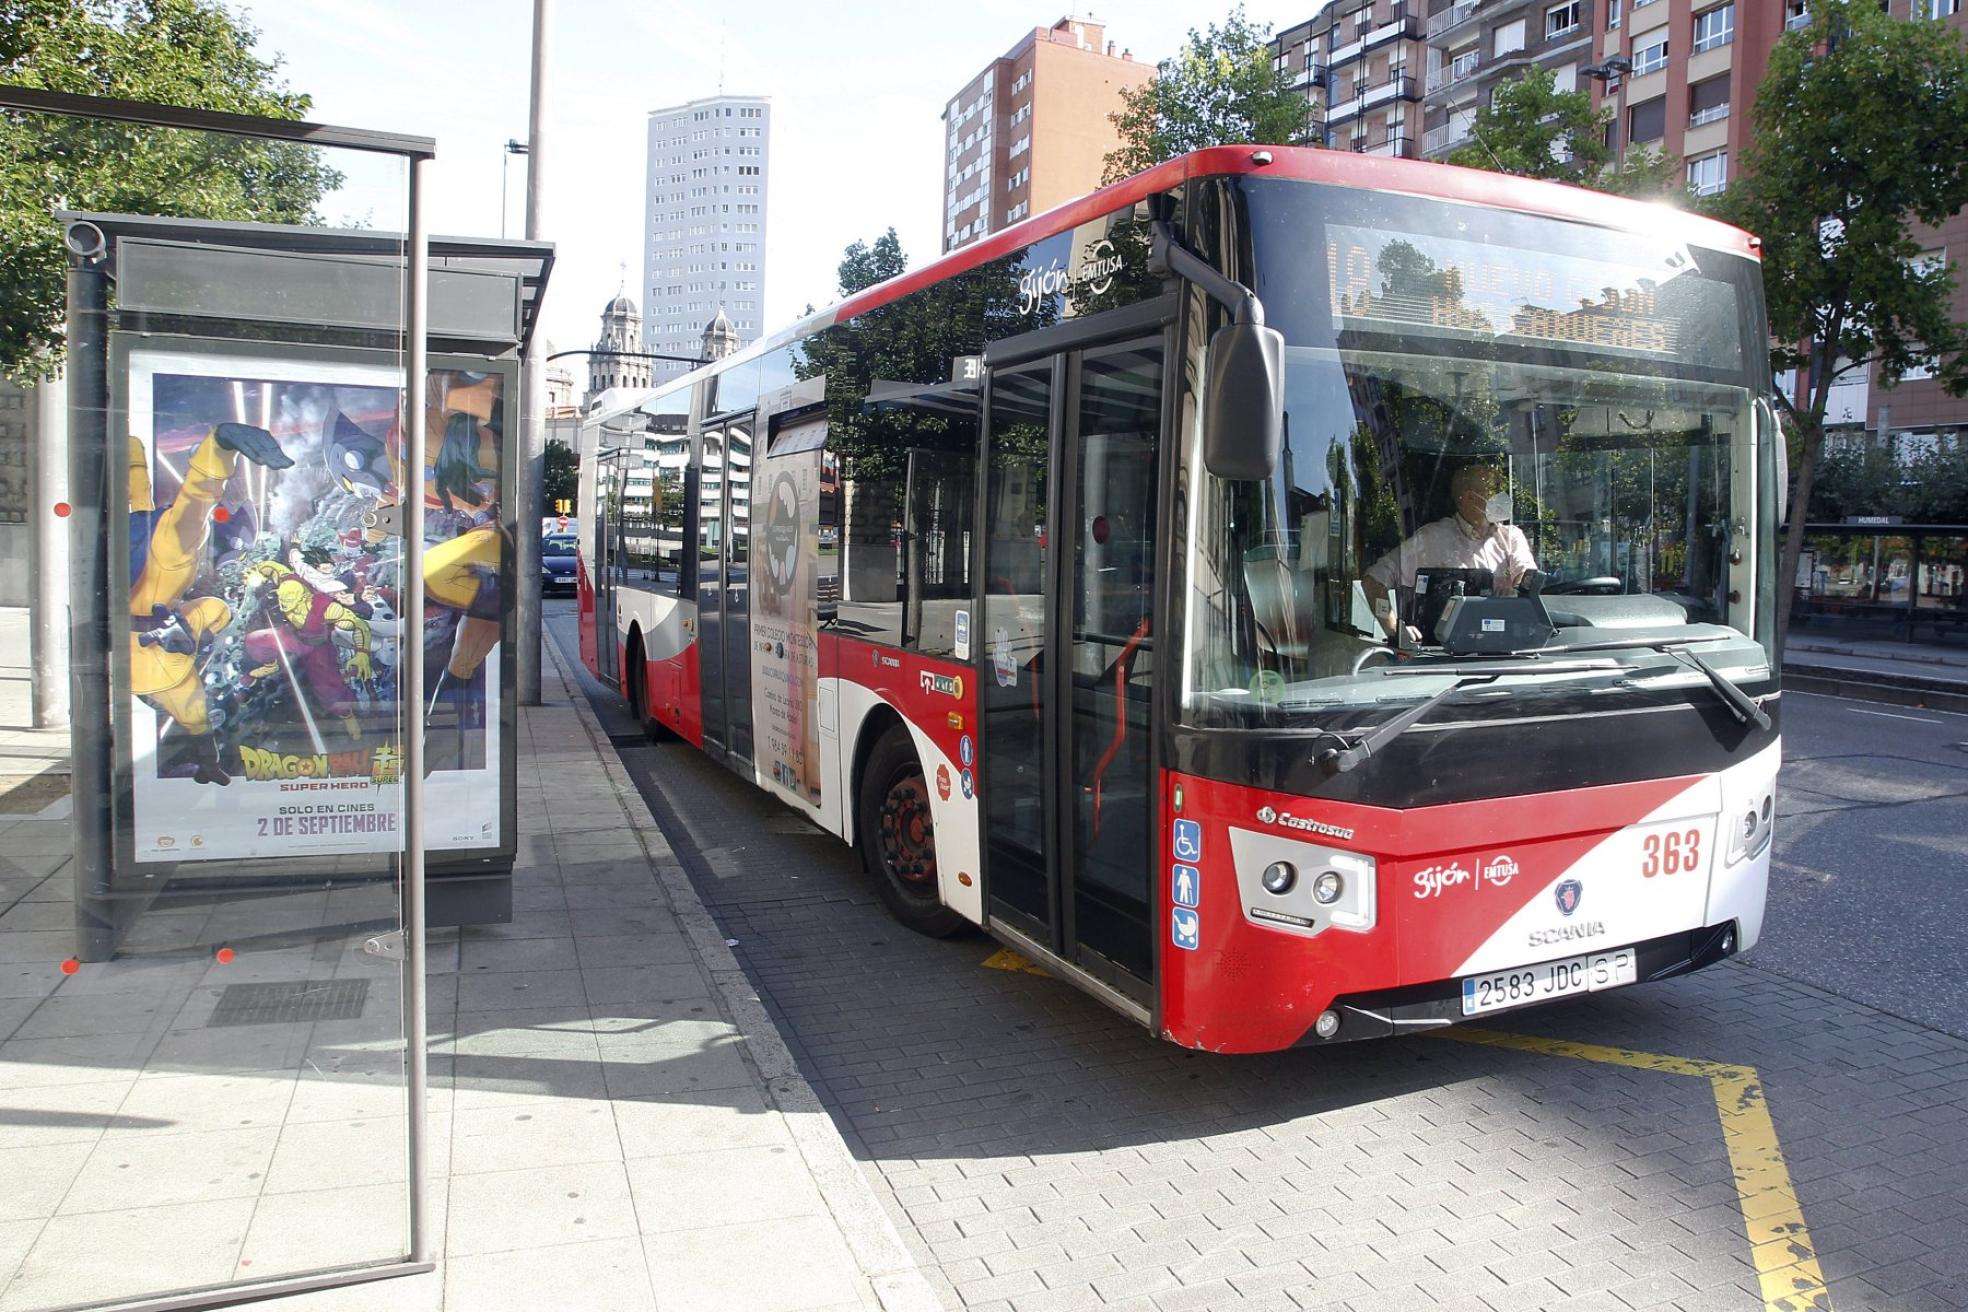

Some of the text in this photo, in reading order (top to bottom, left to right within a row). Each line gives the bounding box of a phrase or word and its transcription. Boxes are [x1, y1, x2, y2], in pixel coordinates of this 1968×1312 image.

[1082, 254, 1123, 283] EMTUSA
[1019, 258, 1069, 315] gijón
[238, 744, 329, 782] DRAGON
[280, 781, 369, 792] SUPER HERO
[279, 803, 375, 815] SOLO EN CINES
[257, 813, 397, 837] 2 DE SEPTIEMBRE
[1278, 812, 1354, 840] Castrosua
[1642, 828, 1701, 879] 363
[1413, 861, 1470, 899] gijón
[1484, 862, 1519, 880] EMTUSA
[1528, 920, 1606, 948] SCANIA
[1479, 961, 1582, 1007] 2583 JDC
